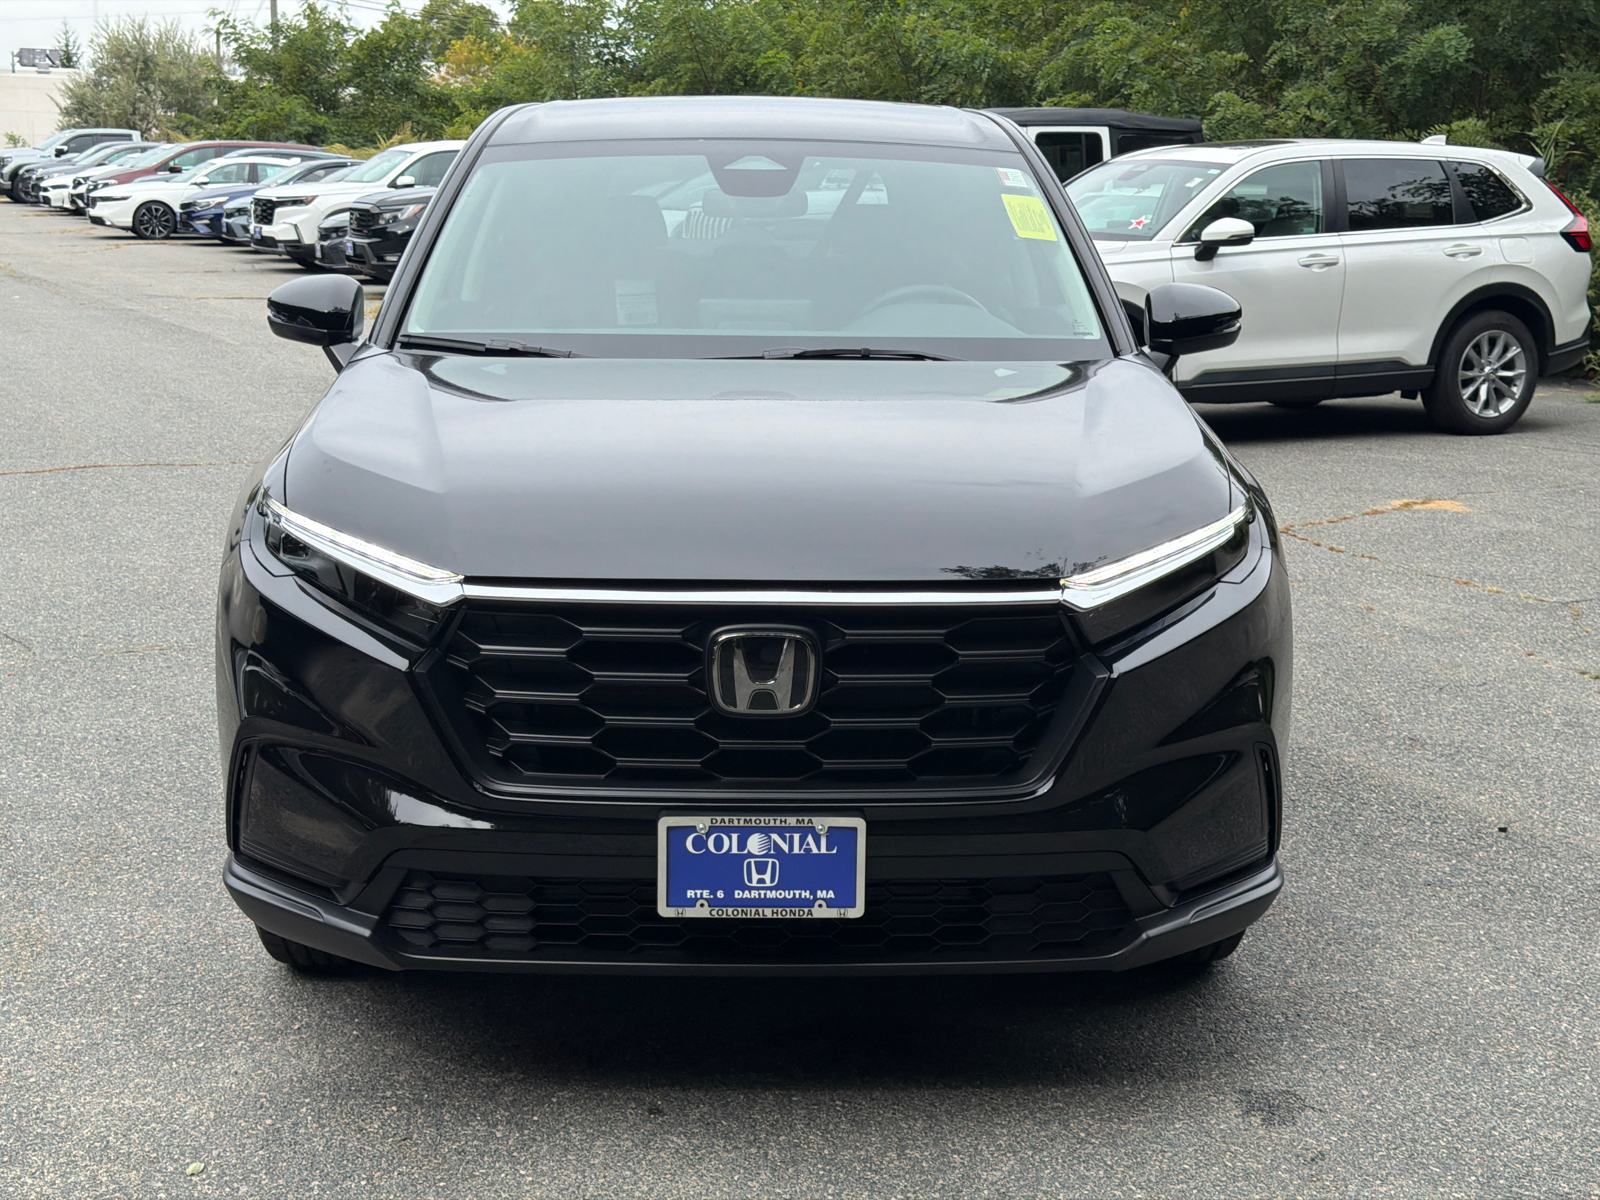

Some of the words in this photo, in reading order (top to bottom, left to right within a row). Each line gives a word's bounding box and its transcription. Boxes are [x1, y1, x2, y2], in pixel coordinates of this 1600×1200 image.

[796, 818, 814, 826] MA
[686, 833, 837, 855] COLONIAL
[686, 890, 713, 898] RTE.
[717, 890, 724, 898] 6
[734, 890, 813, 900] DARTMOUTH,
[817, 890, 835, 898] MA
[709, 909, 767, 917] COLONIAL
[772, 909, 814, 917] HONDA
